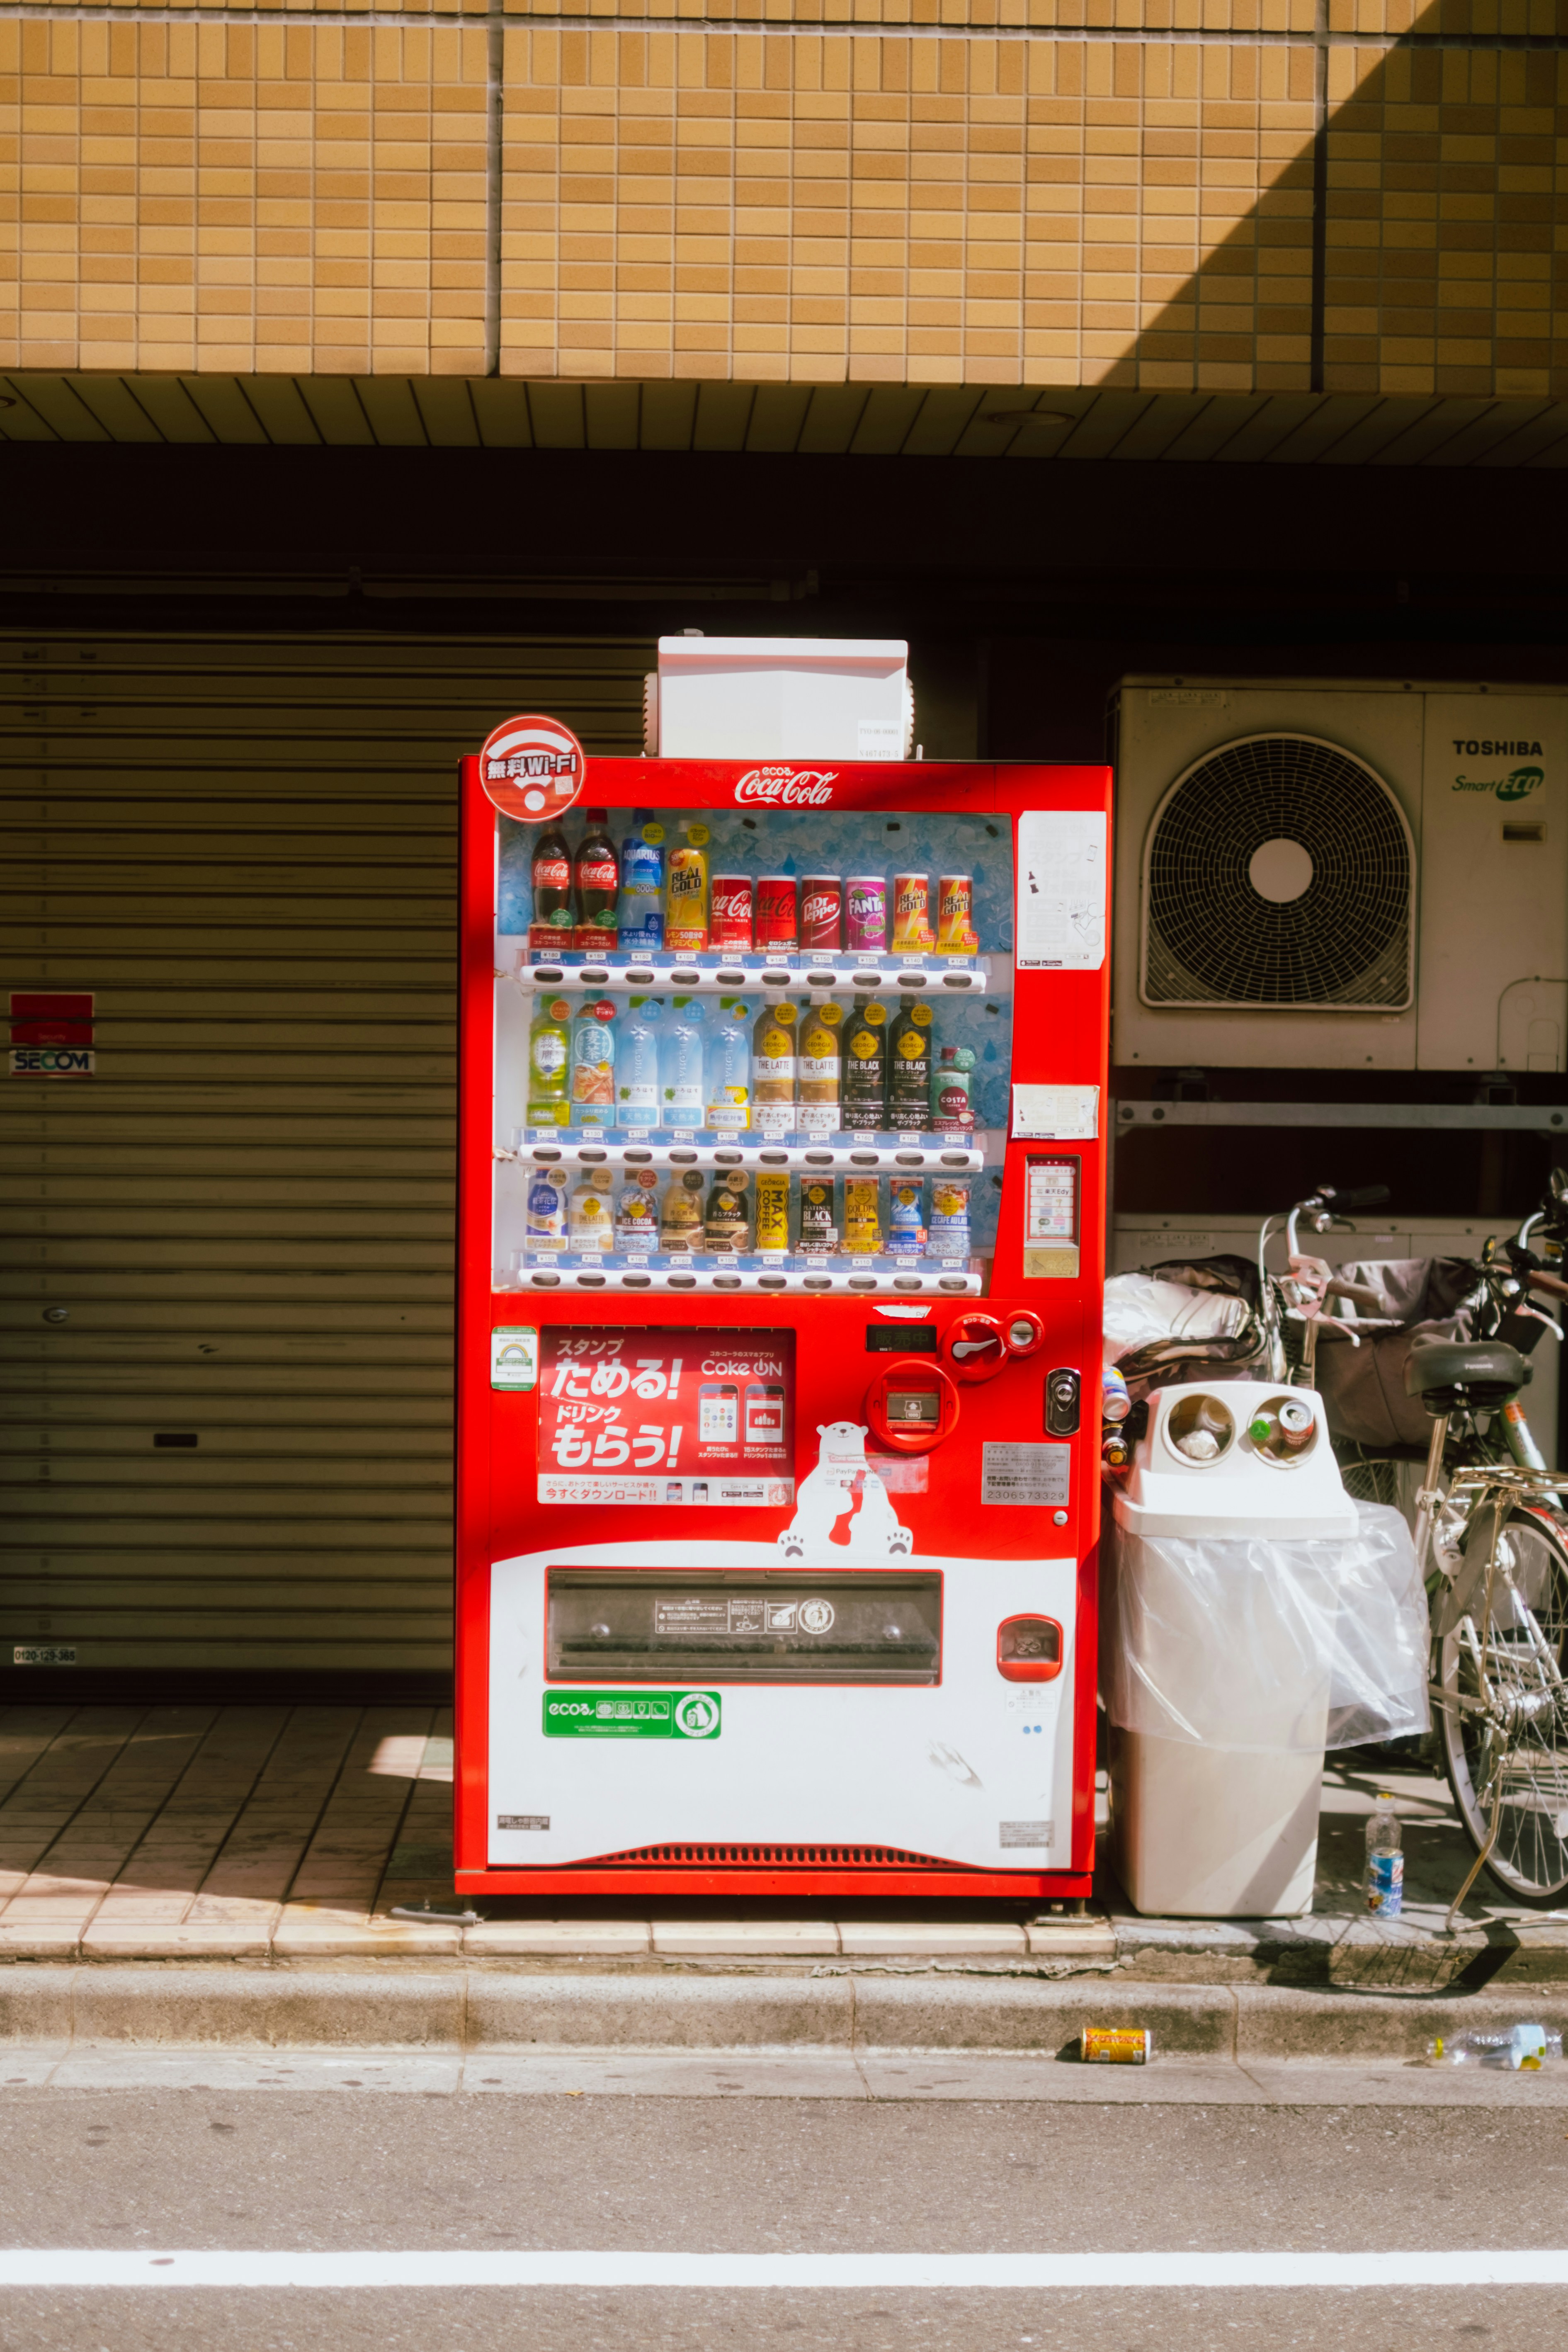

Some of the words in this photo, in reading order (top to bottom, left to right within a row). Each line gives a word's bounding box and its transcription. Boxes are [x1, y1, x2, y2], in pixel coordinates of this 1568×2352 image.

[1453, 740, 1543, 756] TOSHIBA
[488, 754, 576, 779] 無料Wi-Fi
[735, 770, 839, 804] Coca-Cola
[1451, 775, 1495, 791] Smart
[1496, 773, 1543, 794] ECO
[624, 850, 660, 860] AQUARIUS
[534, 862, 568, 877] Coca-Cola
[581, 864, 615, 879] Coca-Cola
[672, 866, 701, 884] REAL
[636, 884, 655, 893] 600ml
[672, 878, 701, 893] GOLD
[813, 897, 828, 907] Dr
[900, 888, 925, 903] REAL
[944, 890, 968, 907] REAL
[803, 902, 837, 922] Pepper
[848, 896, 883, 916] FANTA
[900, 898, 925, 913] GOLD
[944, 901, 969, 916] GOLD
[585, 1030, 601, 1060] 麦茶
[15, 1051, 89, 1070] SECOM
[759, 1061, 769, 1069] THE
[771, 1061, 789, 1069] LATTE
[803, 1061, 814, 1070] THE
[816, 1061, 834, 1070] LATTE
[848, 1061, 859, 1069] THE
[859, 1061, 879, 1070] BLACK
[894, 1061, 905, 1070] THE
[906, 1061, 926, 1070] BLACK
[626, 1112, 650, 1121] 天然水
[671, 1113, 695, 1121] 天然水
[771, 1190, 783, 1229] MAX
[803, 1211, 832, 1221] BLACK
[848, 1205, 876, 1214] GOLDEN
[876, 1331, 929, 1345] 販売中
[557, 1339, 624, 1355] スタンプ
[701, 1360, 749, 1376] Coke
[753, 1359, 782, 1376] ON
[551, 1358, 683, 1399] ためる!
[557, 1405, 621, 1423] ドリンク
[551, 1425, 683, 1468] もらう!
[988, 1491, 1064, 1500] 2306573329
[805, 1622, 828, 1632] リサイクル
[15, 1651, 75, 1661] 0120-129-365
[681, 1694, 713, 1706] のんだあとは
[684, 1728, 710, 1737] リサイクル
